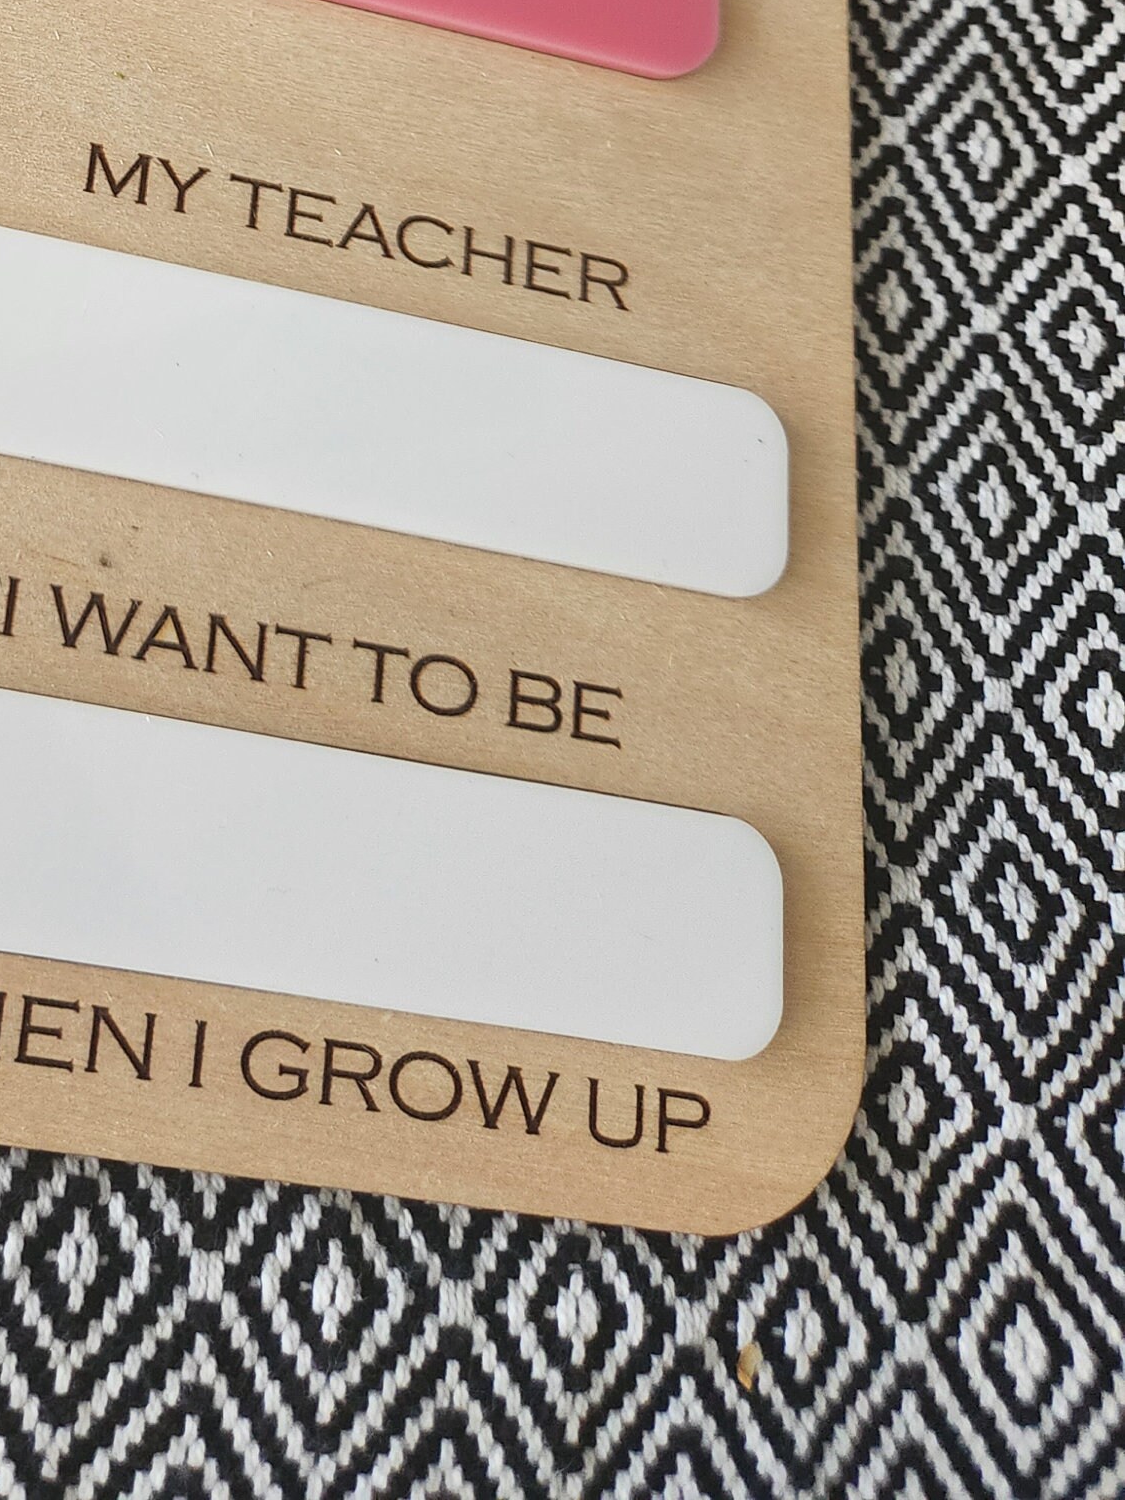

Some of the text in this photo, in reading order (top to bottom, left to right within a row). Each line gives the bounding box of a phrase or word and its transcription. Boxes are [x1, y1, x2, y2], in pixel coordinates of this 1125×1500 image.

[83, 142, 629, 311] MY TEACHER
[0, 576, 622, 749] I WANT TO BE
[189, 1019, 209, 1089] I
[241, 1029, 560, 1136] GROW
[587, 1077, 711, 1153] UP
